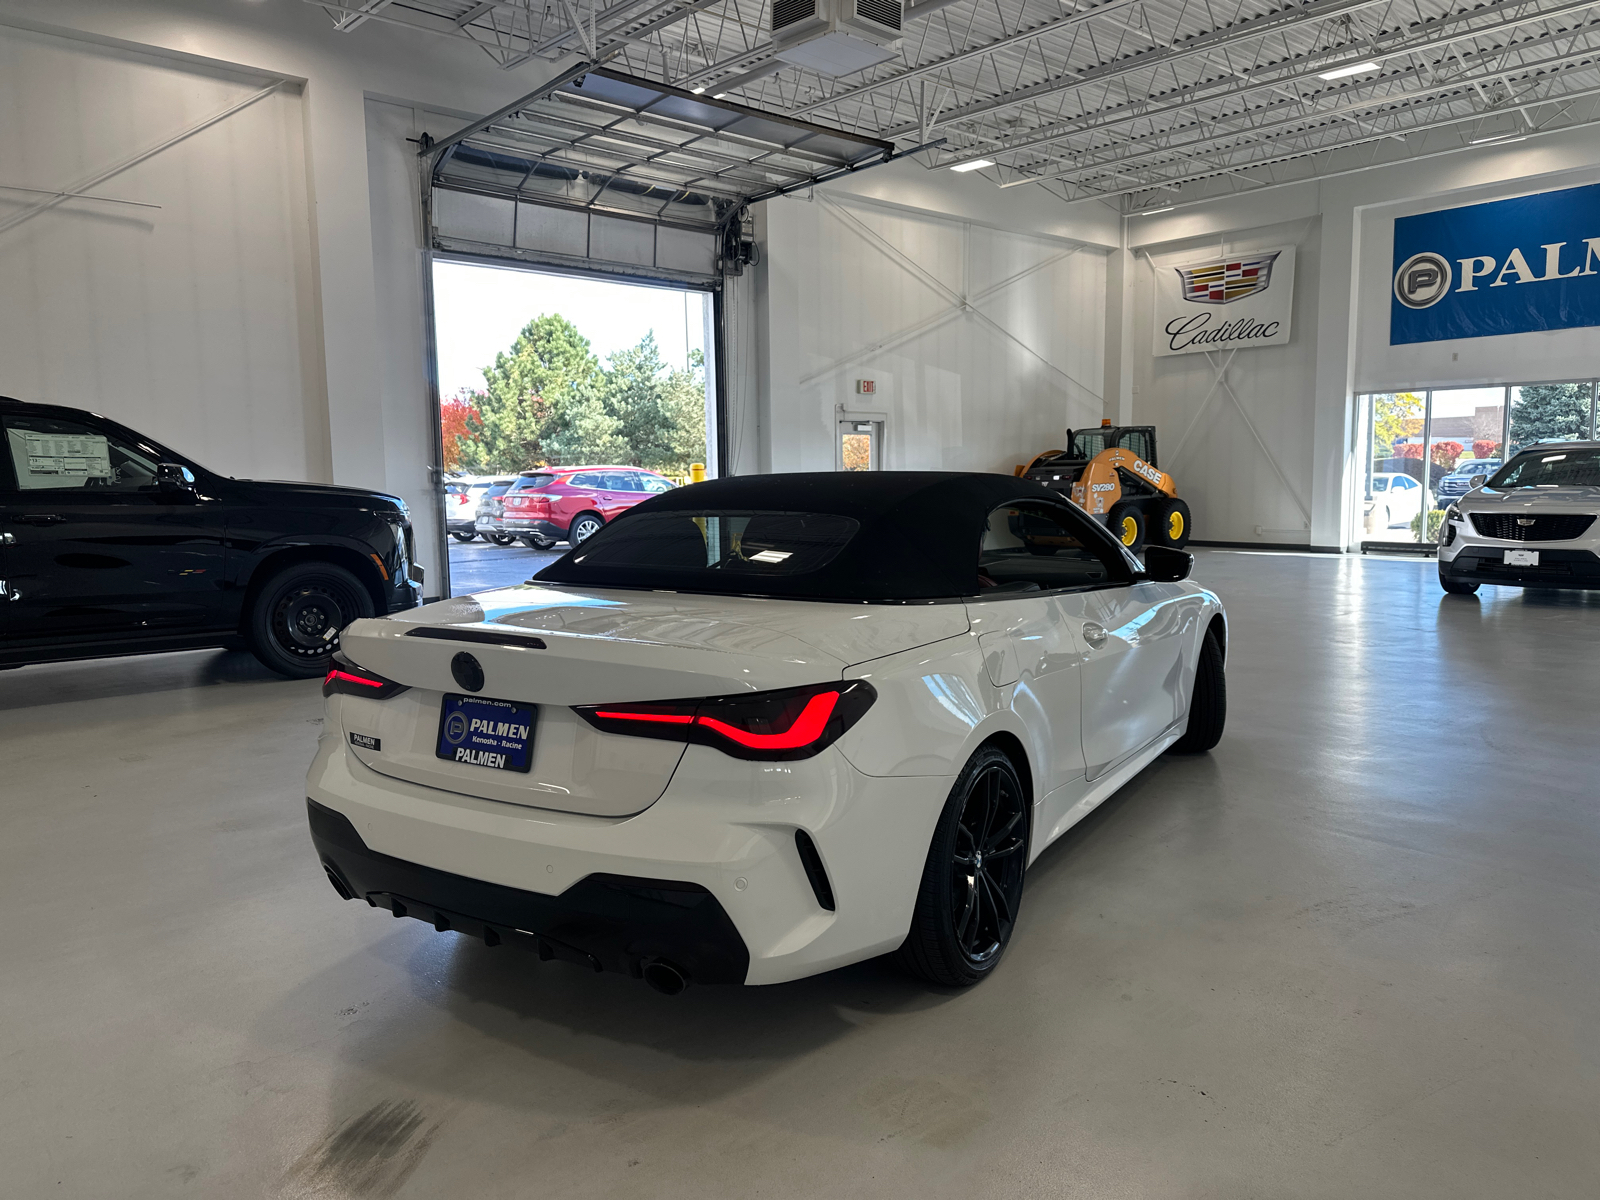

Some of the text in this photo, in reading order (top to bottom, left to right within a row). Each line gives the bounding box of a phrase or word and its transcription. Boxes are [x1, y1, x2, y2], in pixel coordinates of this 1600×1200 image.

[1165, 312, 1280, 351] Cadillac
[863, 381, 874, 392] EXIT
[1133, 460, 1162, 485] CASE
[1091, 483, 1115, 492] SV280
[463, 697, 512, 708] palmen.com
[470, 718, 530, 740] PALMEN
[353, 734, 376, 746] PALMEN
[472, 735, 497, 746] Kenosha
[501, 740, 522, 750] Racine
[455, 747, 506, 769] PALMEN
